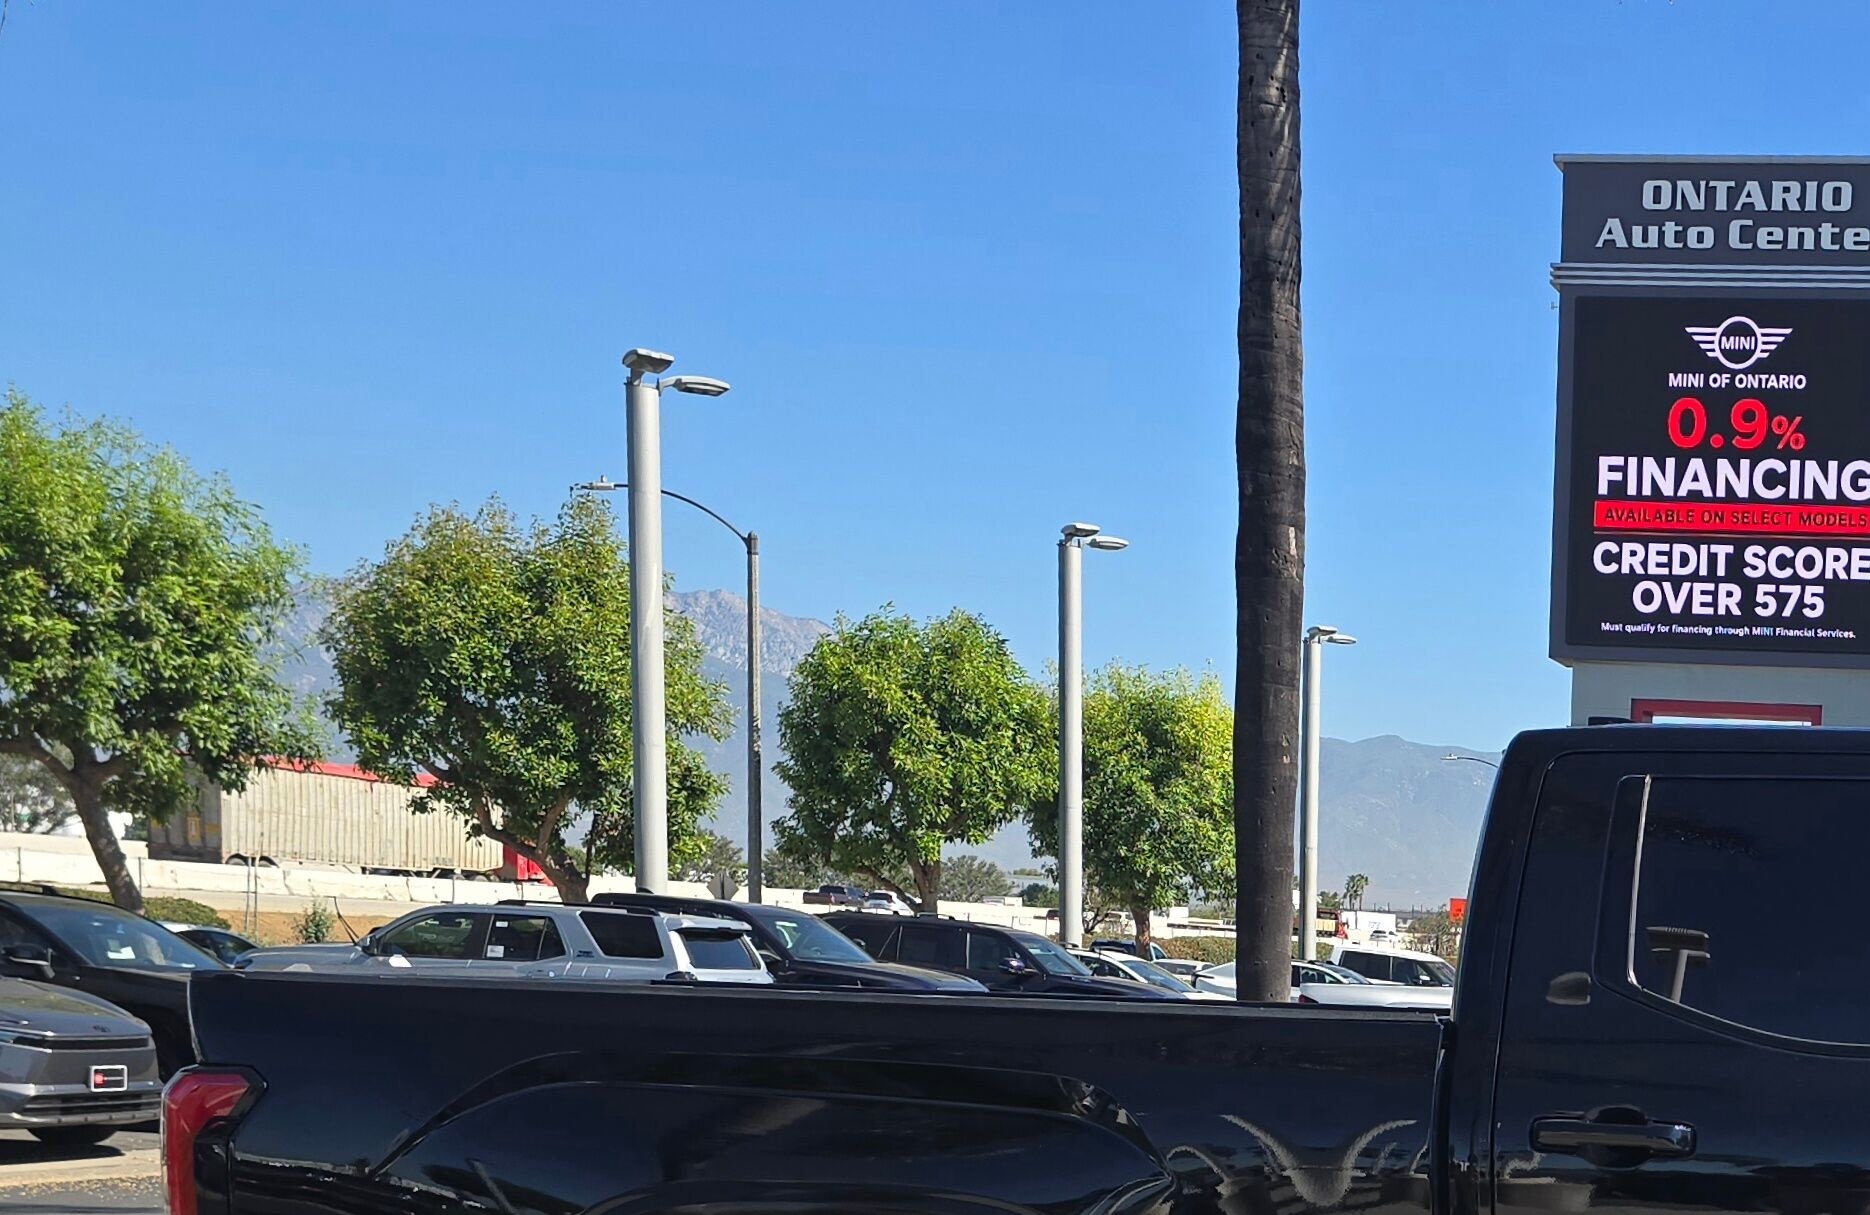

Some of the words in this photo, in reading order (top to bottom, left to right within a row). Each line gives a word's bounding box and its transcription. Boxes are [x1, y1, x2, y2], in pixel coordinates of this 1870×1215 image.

[1642, 179, 1853, 212] ONTARIO
[1595, 217, 1715, 250] Auto
[1721, 336, 1755, 350] MINI
[1669, 373, 1704, 388] MINI
[1709, 374, 1731, 388] OF
[1735, 374, 1806, 390] ONTARIO
[1667, 397, 1806, 451] 0.9%
[1604, 506, 1695, 523] AVAILABLE
[1700, 510, 1725, 525] ON
[1730, 511, 1791, 526] SELECT
[1800, 512, 1868, 528] MODELS
[1593, 541, 1734, 577] CREDIT
[1632, 580, 1742, 616] OVER
[1754, 584, 1825, 618] 575
[1601, 622, 1623, 631] Must
[1625, 624, 1655, 633] qualify
[1657, 624, 1669, 633] for
[1672, 624, 1712, 636] financing
[1715, 626, 1750, 636] through
[1752, 627, 1773, 636] MINI
[1776, 627, 1815, 637] Financial
